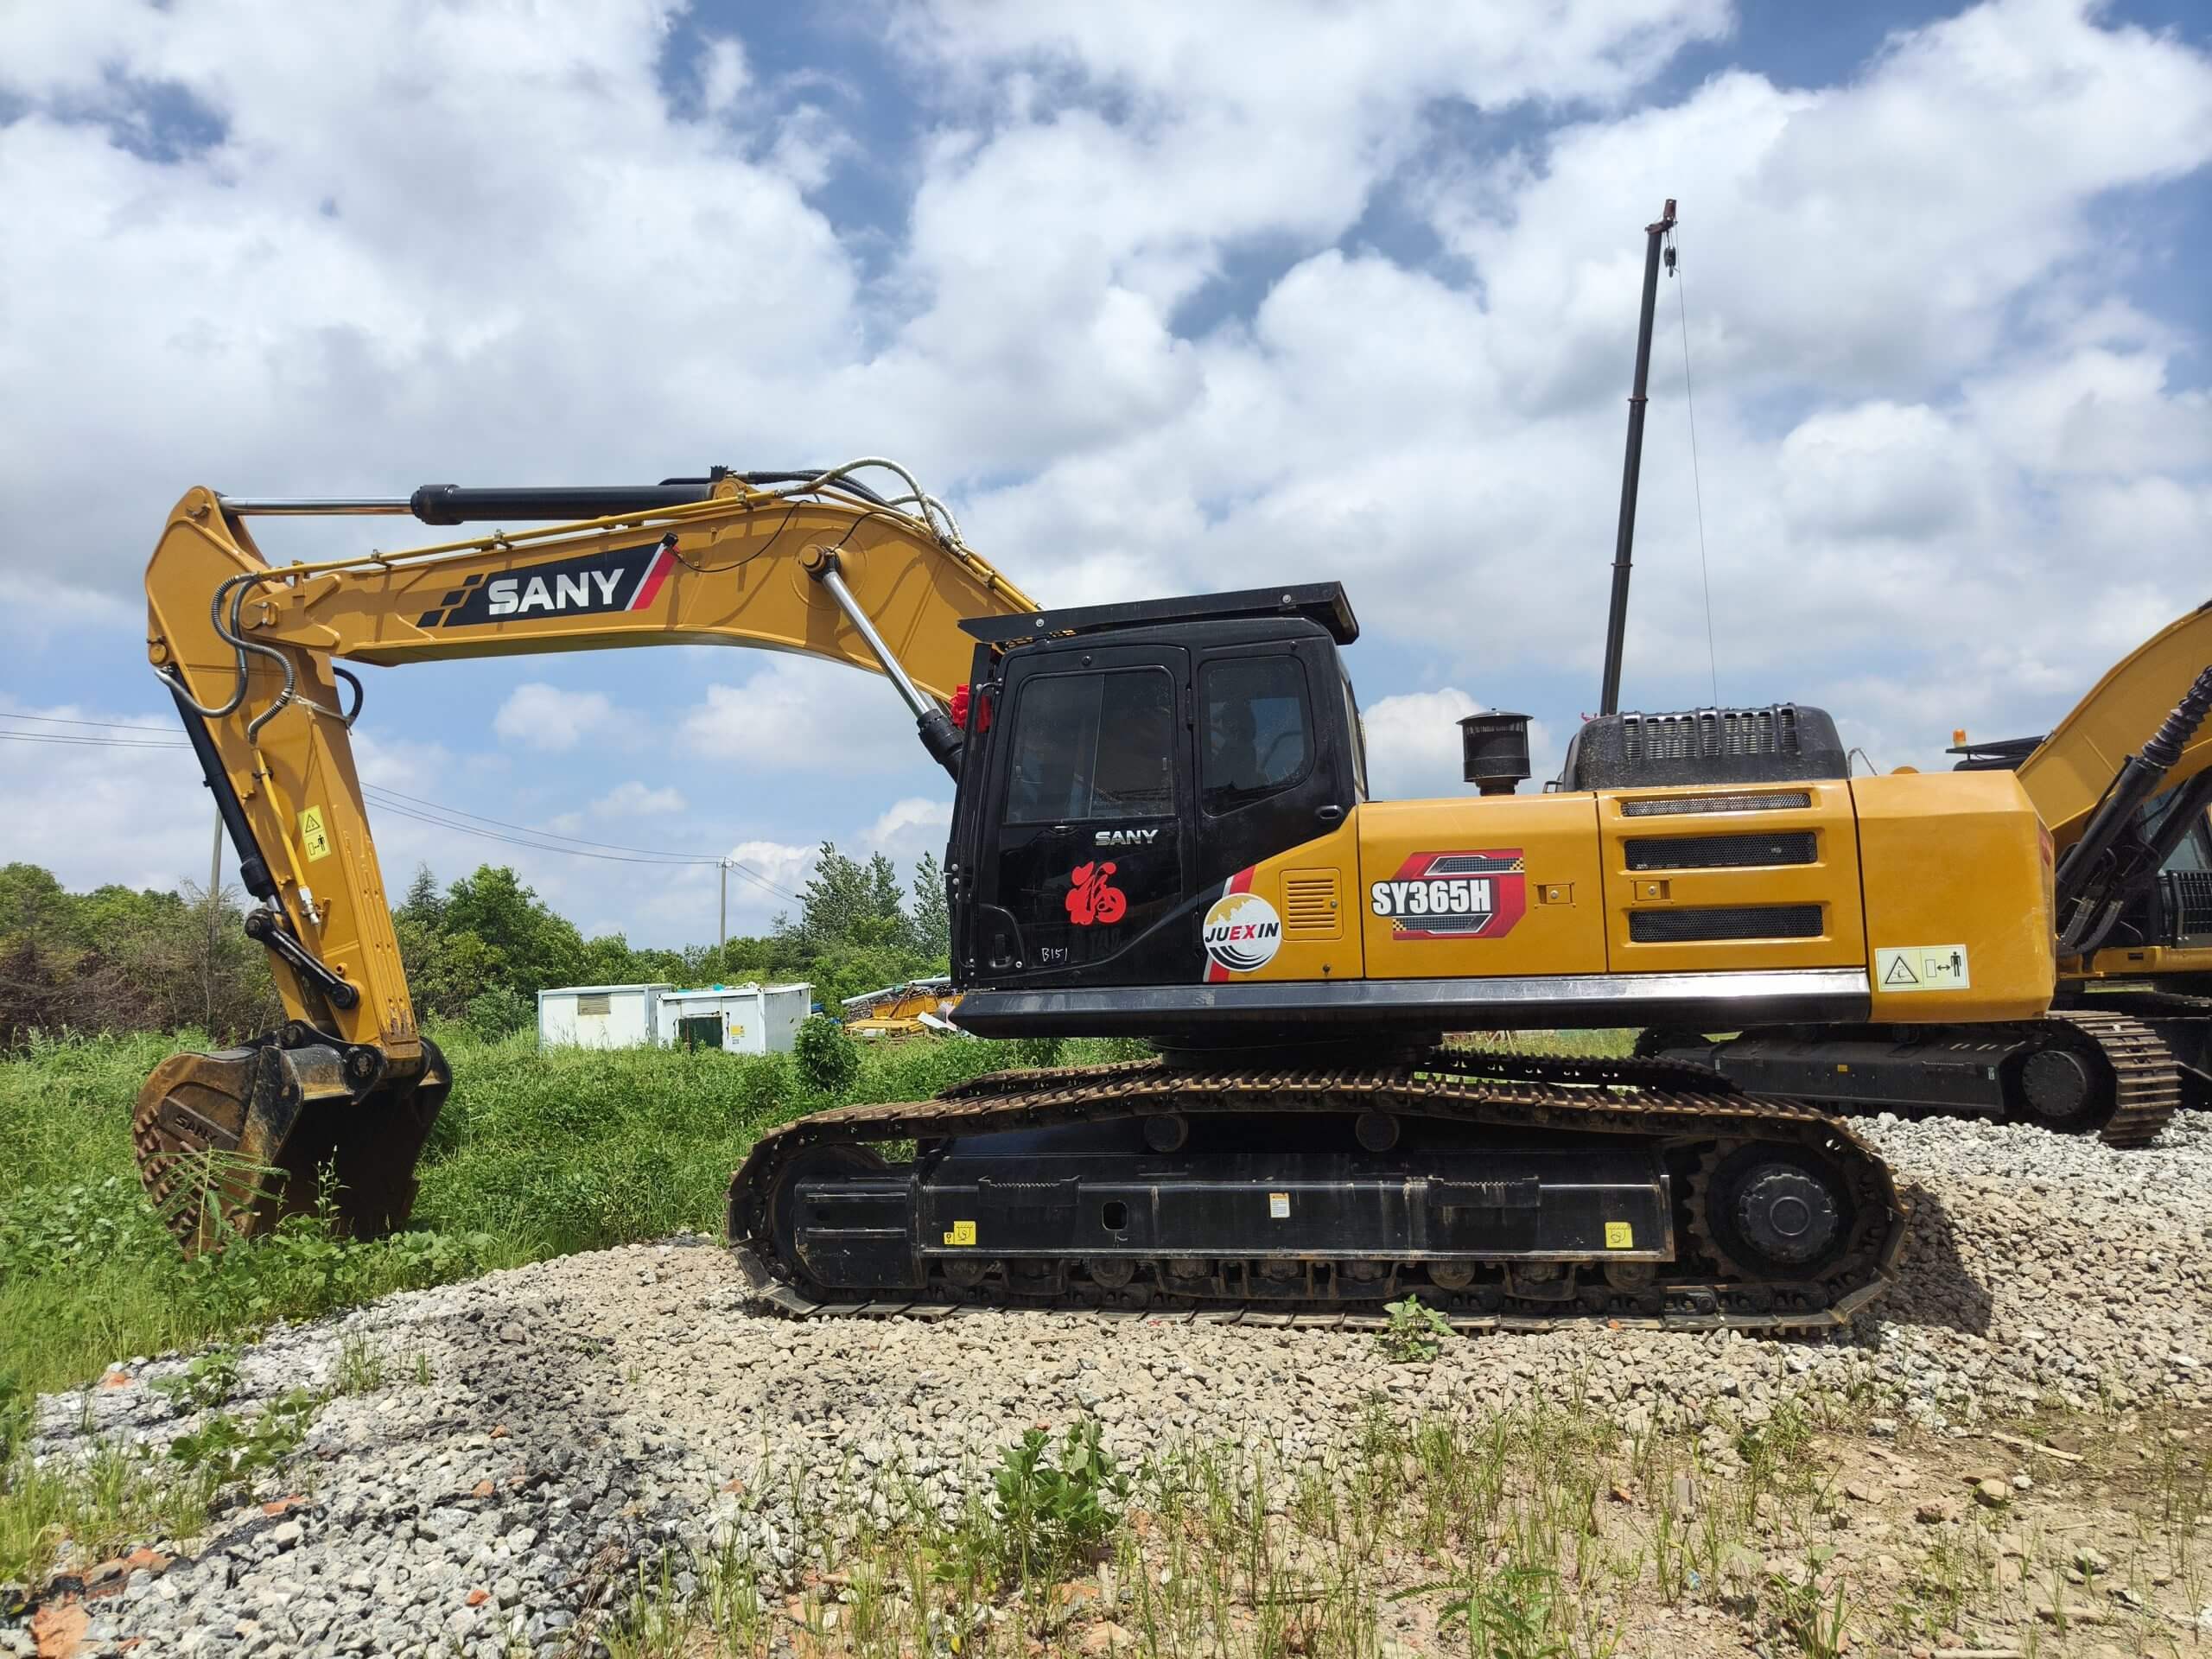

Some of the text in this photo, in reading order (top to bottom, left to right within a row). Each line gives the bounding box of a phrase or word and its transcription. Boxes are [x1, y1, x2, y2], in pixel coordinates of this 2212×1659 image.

[488, 568, 625, 615] SANY
[1095, 829, 1159, 846] SANY
[1065, 861, 1127, 925] 福
[1370, 878, 1492, 916] SY365H
[1205, 922, 1280, 944] JUEXIN
[1041, 947, 1068, 962] B151
[174, 1113, 219, 1142] SANY
